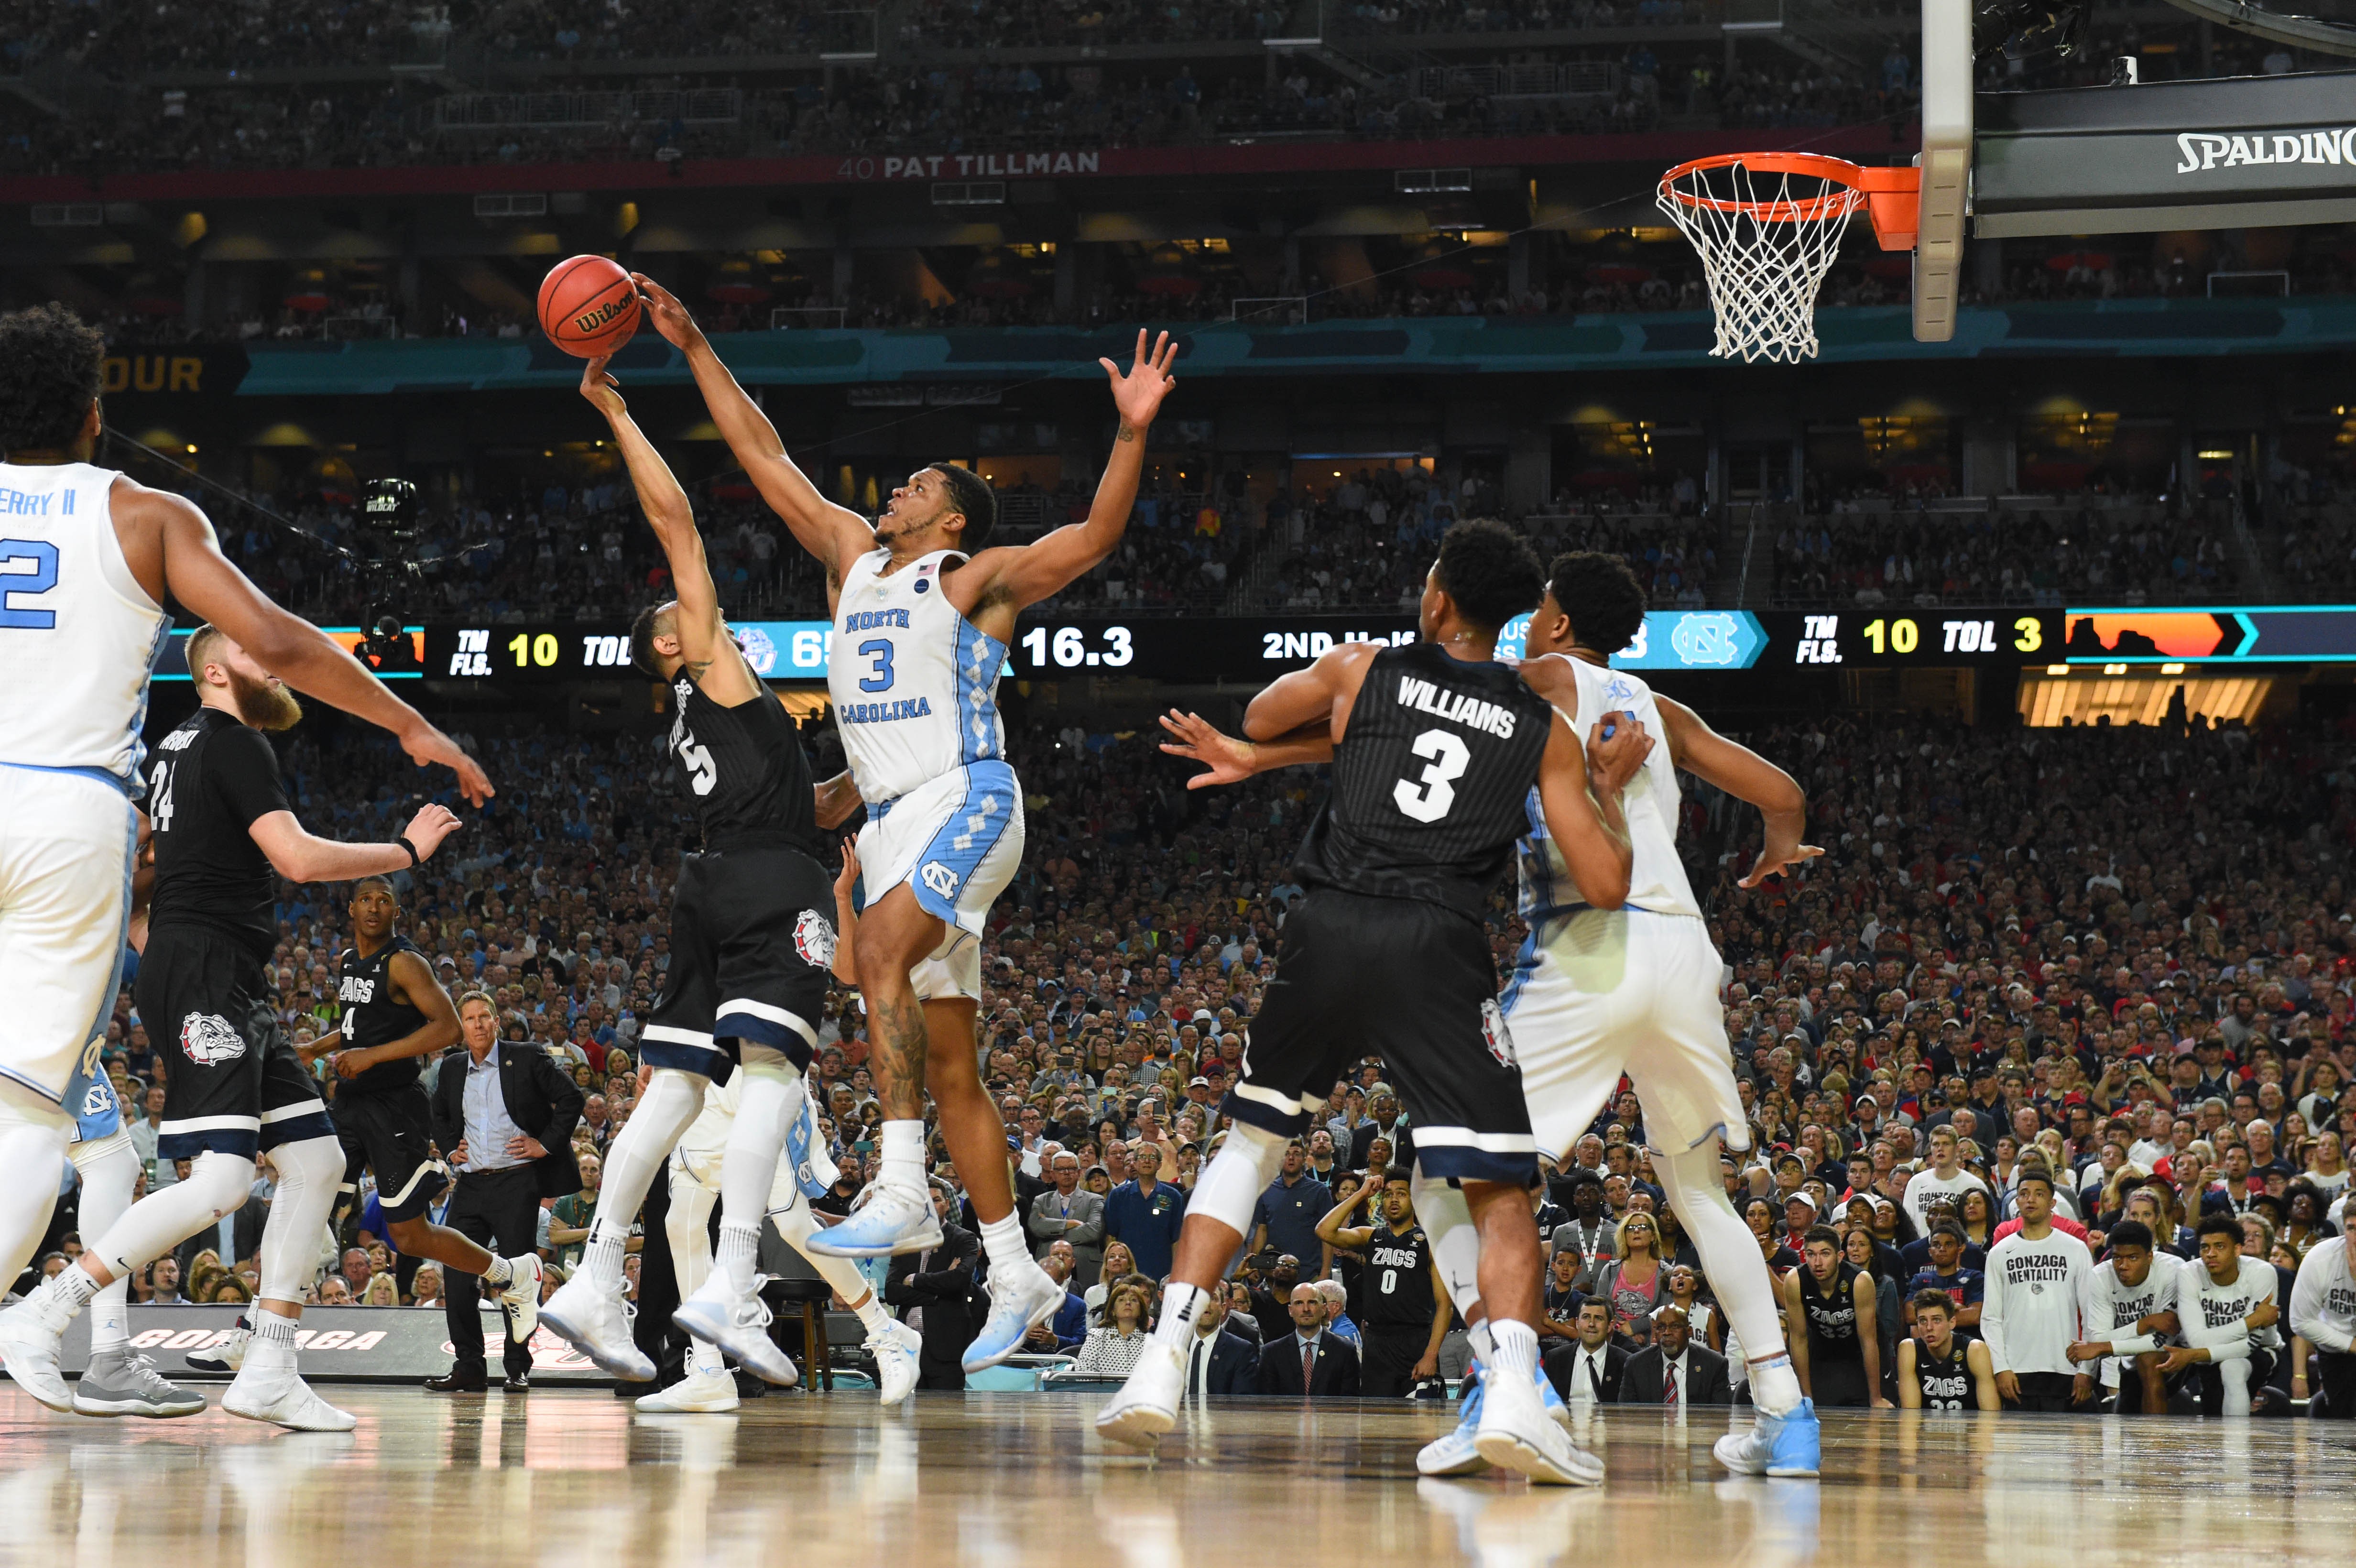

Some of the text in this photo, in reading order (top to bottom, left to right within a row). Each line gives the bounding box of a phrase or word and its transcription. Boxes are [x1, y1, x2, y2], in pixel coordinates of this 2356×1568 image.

[838, 152, 1099, 180] 40 PAT TILLMAN
[575, 290, 635, 333] Wilson
[102, 356, 203, 392] OUR
[0, 488, 54, 515] ERRY
[366, 503, 398, 513] WILDCAT
[0, 538, 59, 629] 2
[845, 608, 910, 634] NORTH
[1804, 615, 1838, 639] TM
[1942, 617, 2042, 652] TOL 3
[458, 630, 490, 653] TM
[1022, 626, 1134, 667] 16.3
[1263, 632, 1333, 659] 2ND
[1864, 619, 1919, 653] 10
[509, 633, 558, 667] 10
[583, 636, 632, 666] TOL
[859, 638, 894, 693] 3
[840, 697, 931, 724] CAROLINA
[1398, 675, 1516, 740] WILLIAMS
[1393, 728, 1471, 824] 3
[150, 760, 176, 832] 24
[339, 976, 375, 1003] ZAGS
[341, 1007, 356, 1040] 4
[1371, 1247, 1417, 1269] ZAGS
[2006, 1254, 2067, 1271] GONZAGA
[1380, 1269, 1397, 1294] 0
[2008, 1268, 2067, 1285] MENTALITY
[1810, 1306, 1855, 1325] ZAGS
[1922, 1375, 1967, 1397] ZAGS
